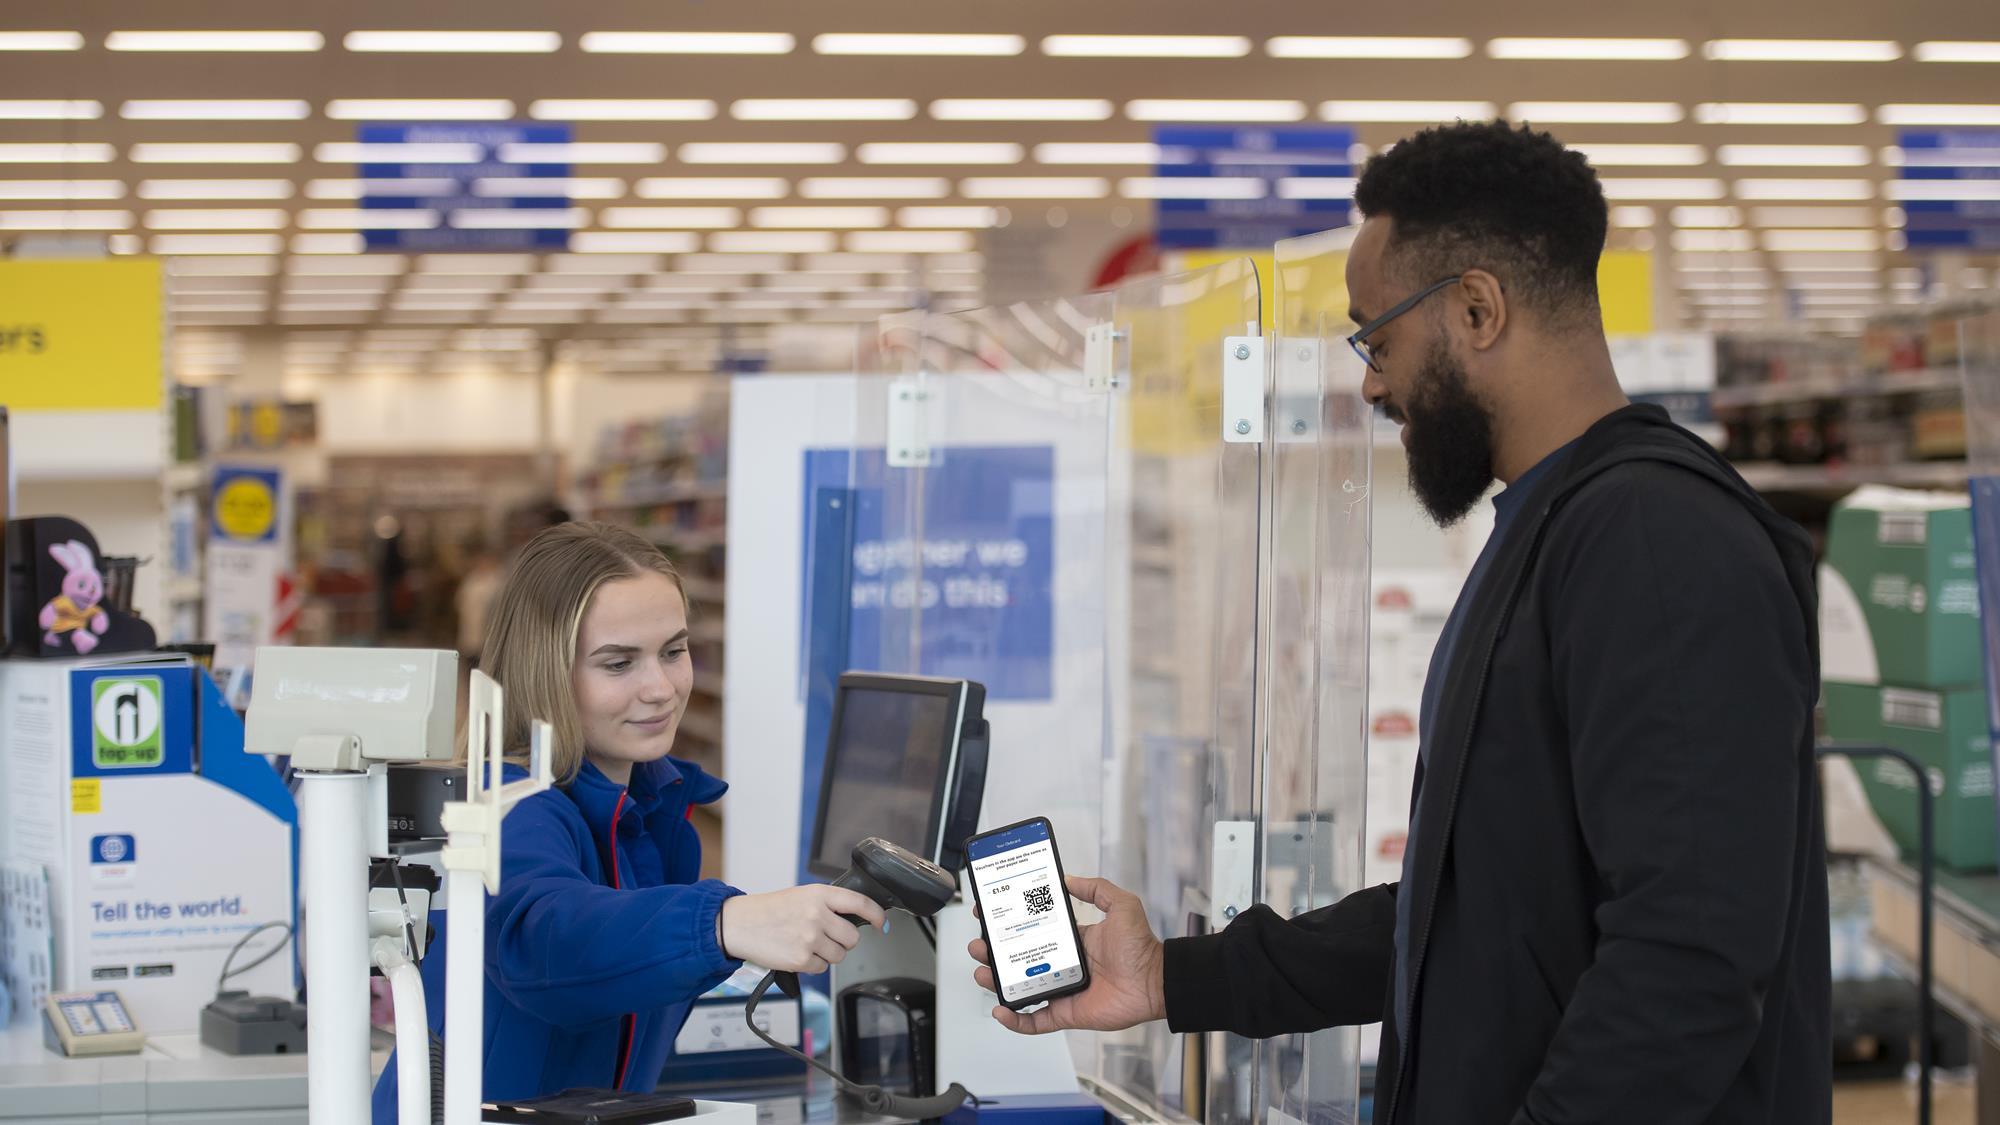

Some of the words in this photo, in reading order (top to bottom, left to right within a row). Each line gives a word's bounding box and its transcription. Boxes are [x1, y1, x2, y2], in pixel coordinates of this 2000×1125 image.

[890, 579, 939, 608] do
[99, 746, 156, 762] top-up
[992, 884, 1010, 894] £1.50
[91, 902, 128, 922] Tell
[135, 900, 171, 920] the
